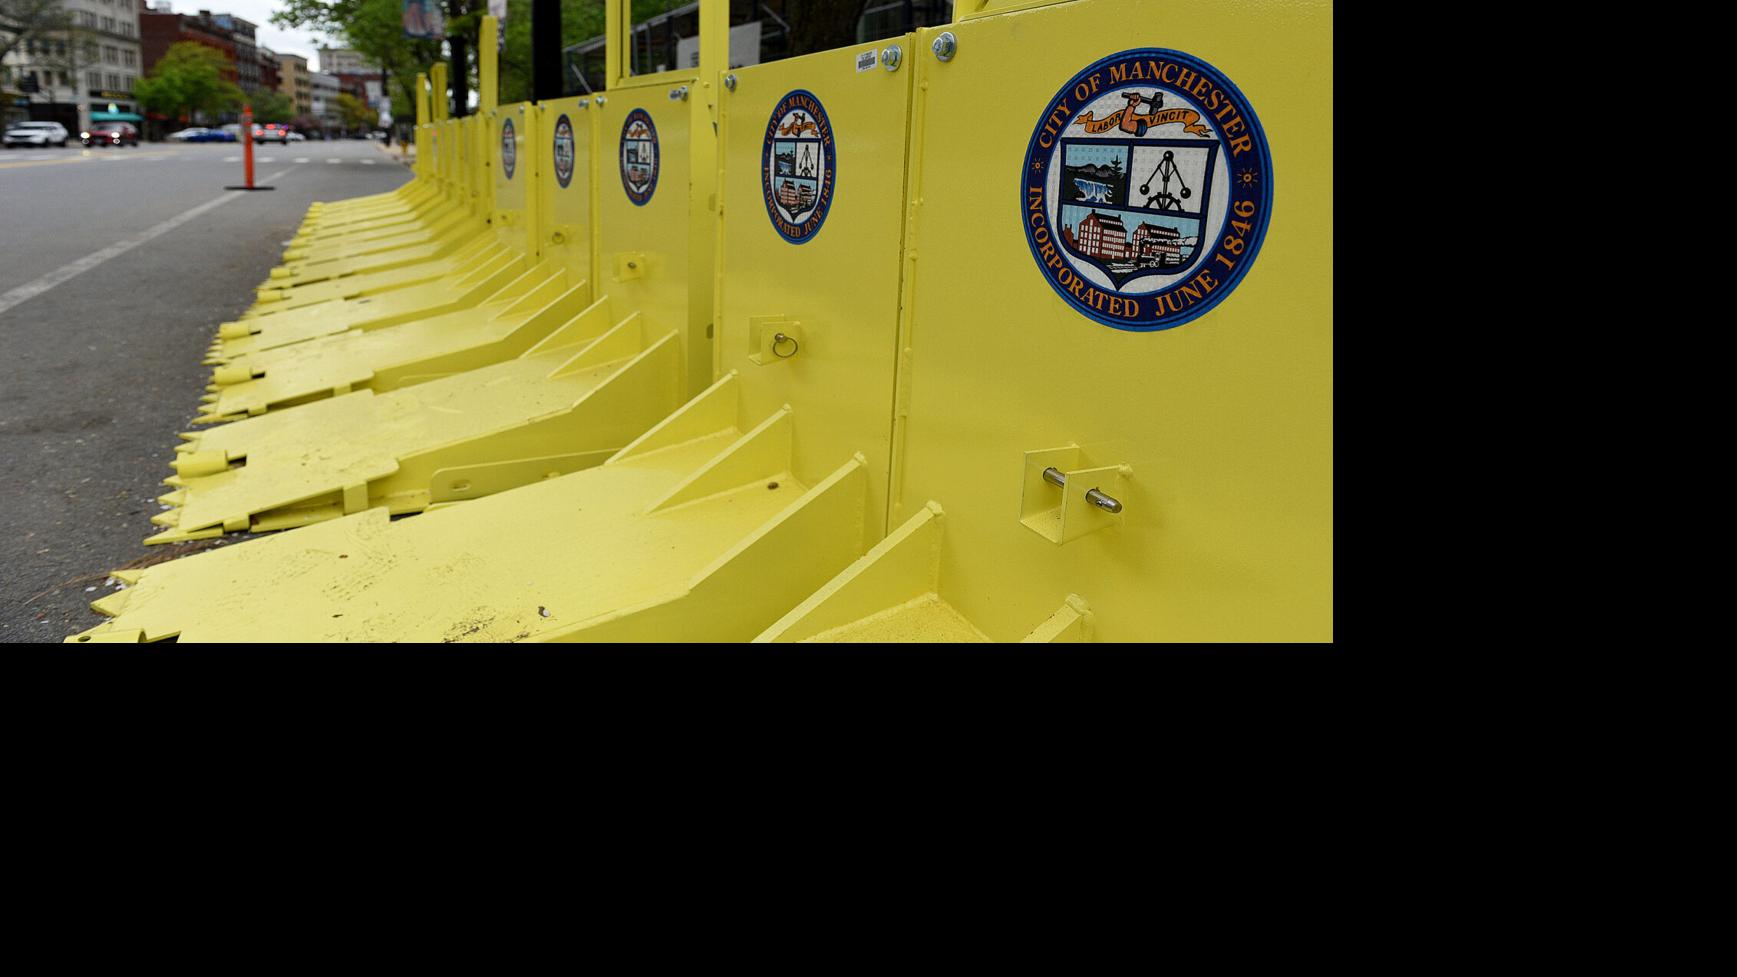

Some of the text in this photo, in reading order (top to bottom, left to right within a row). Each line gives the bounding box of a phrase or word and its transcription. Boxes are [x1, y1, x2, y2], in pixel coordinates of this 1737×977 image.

[788, 95, 831, 145] MANCHESTER
[1039, 60, 1252, 158] CITY OF MANCHESTER
[1092, 110, 1190, 132] LABOR VINCIT
[1029, 186, 1255, 318] INCORPORATED JUNE 1846
